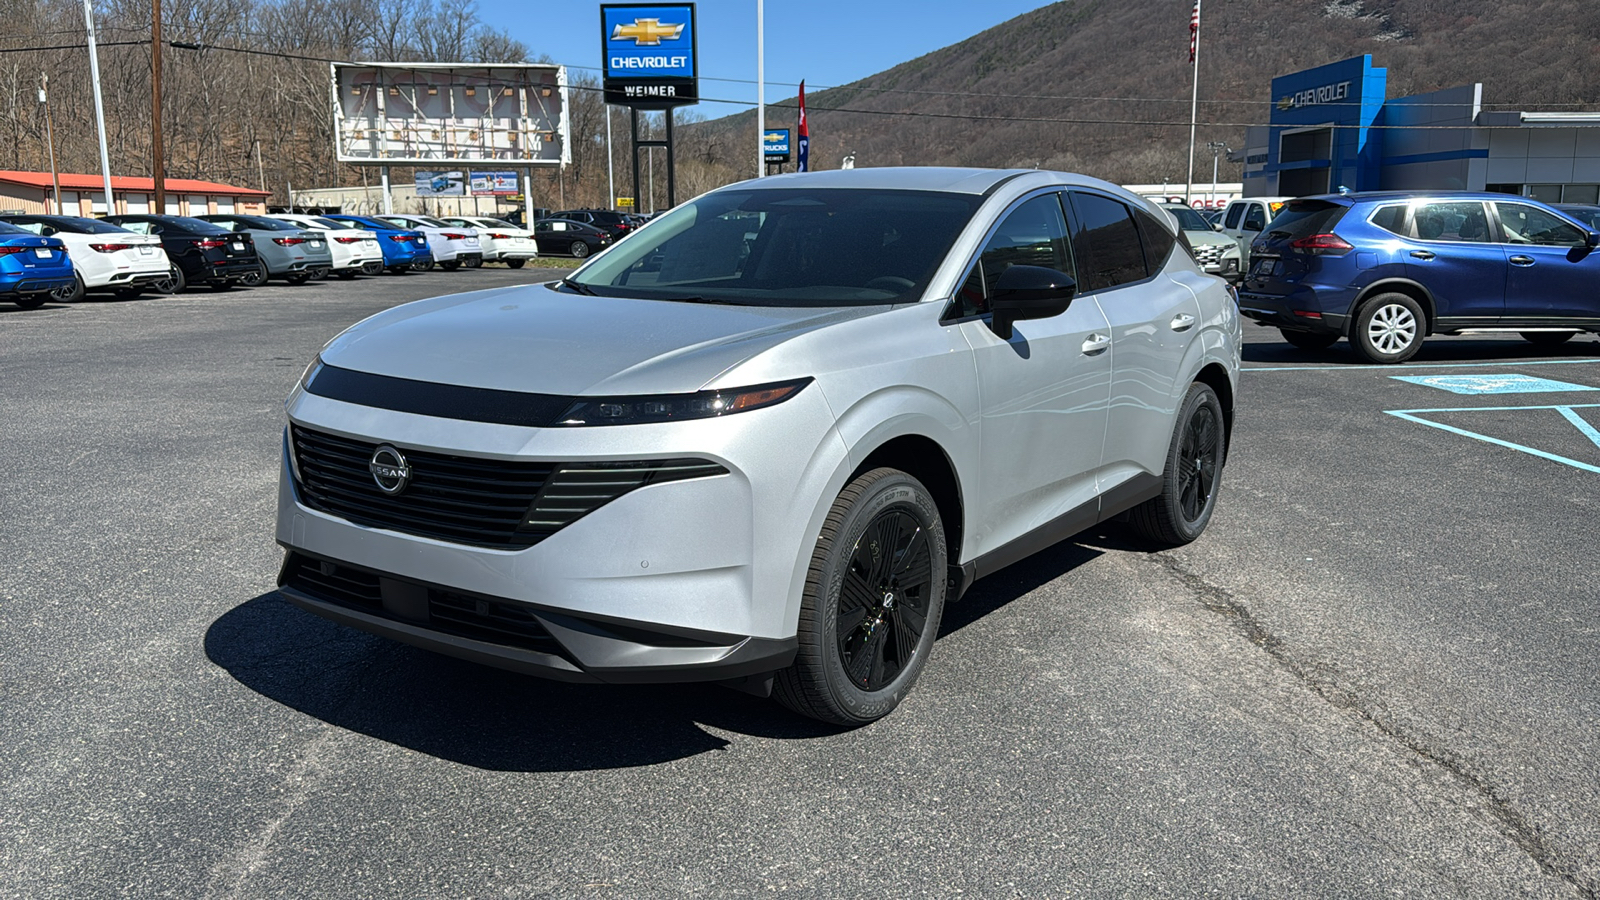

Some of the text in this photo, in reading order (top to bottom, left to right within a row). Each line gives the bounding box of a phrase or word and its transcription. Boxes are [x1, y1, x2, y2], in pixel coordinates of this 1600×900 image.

[611, 56, 687, 69] CHEVROLET
[624, 85, 676, 97] WEIMER
[1294, 82, 1350, 108] CHEVROLET
[369, 466, 406, 477] NISSAN
